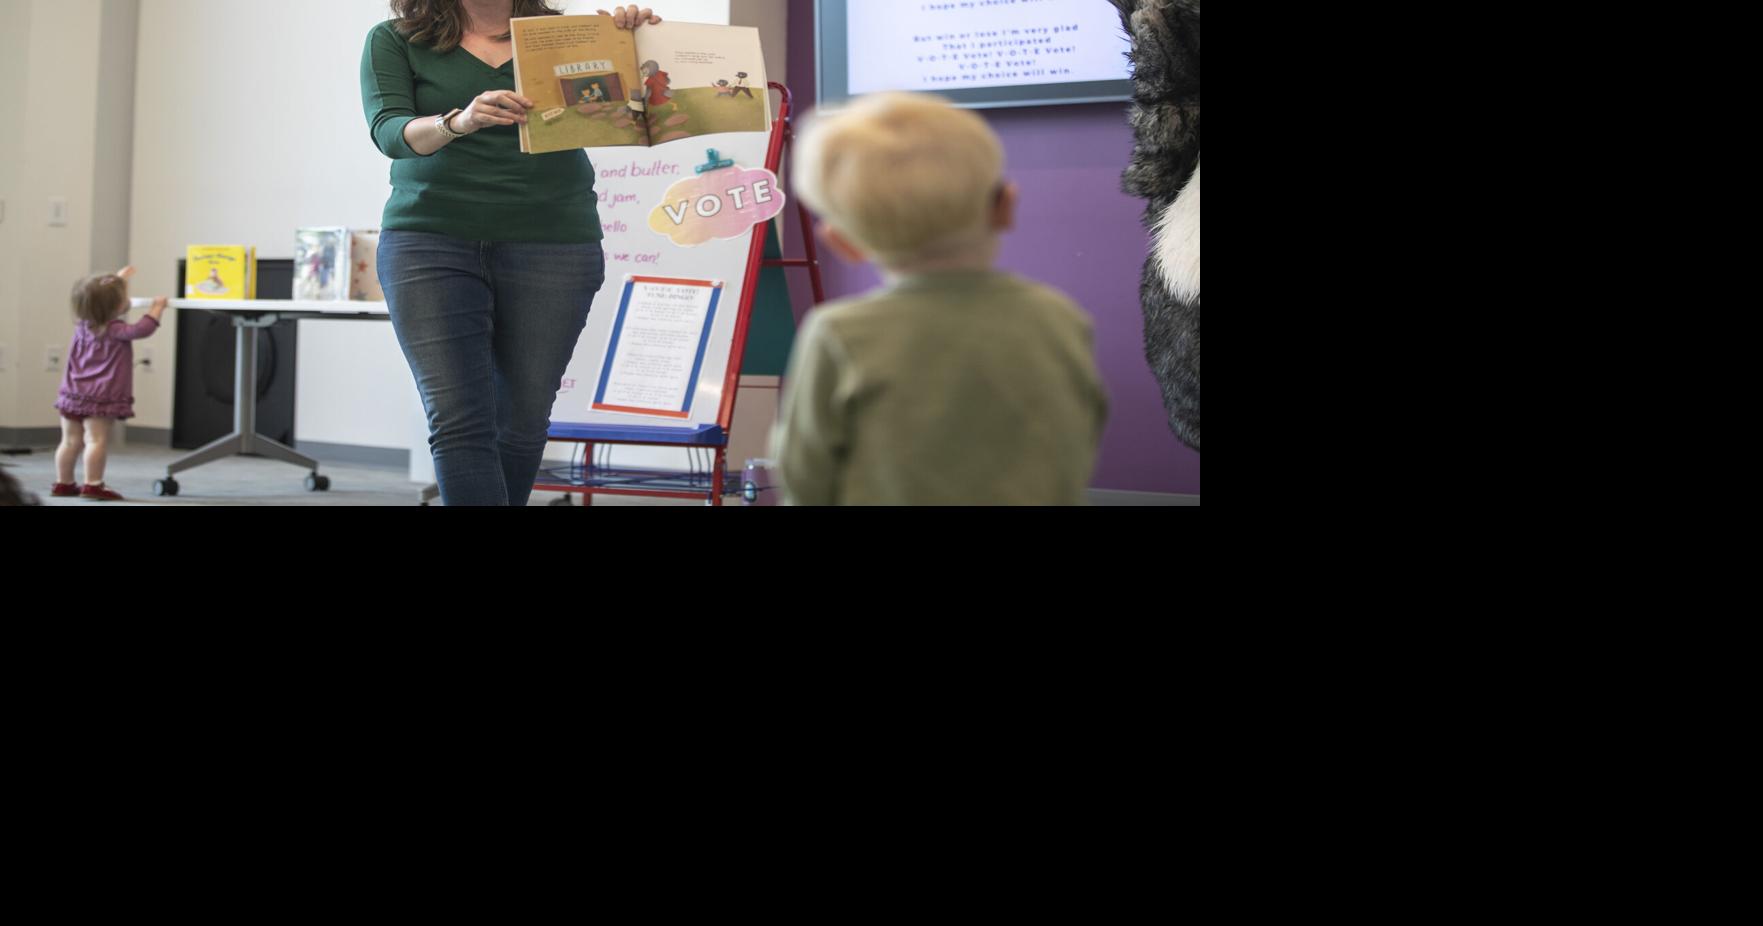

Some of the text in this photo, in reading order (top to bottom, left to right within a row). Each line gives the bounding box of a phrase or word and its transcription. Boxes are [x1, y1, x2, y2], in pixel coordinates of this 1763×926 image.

[913, 34, 932, 43] But
[936, 33, 956, 41] win
[960, 32, 971, 40] or
[975, 31, 998, 39] lose
[1024, 27, 1048, 35] very
[1053, 24, 1079, 34] glad
[943, 41, 967, 50] That
[979, 36, 1052, 49] participated
[558, 61, 607, 74] LIBRARY
[930, 73, 957, 83] hope
[961, 73, 977, 82] my
[981, 70, 1019, 80] choice
[1023, 68, 1046, 77] will
[600, 164, 628, 179] and
[662, 178, 771, 225] VOTE
[613, 252, 630, 262] we
[634, 252, 662, 264] can!
